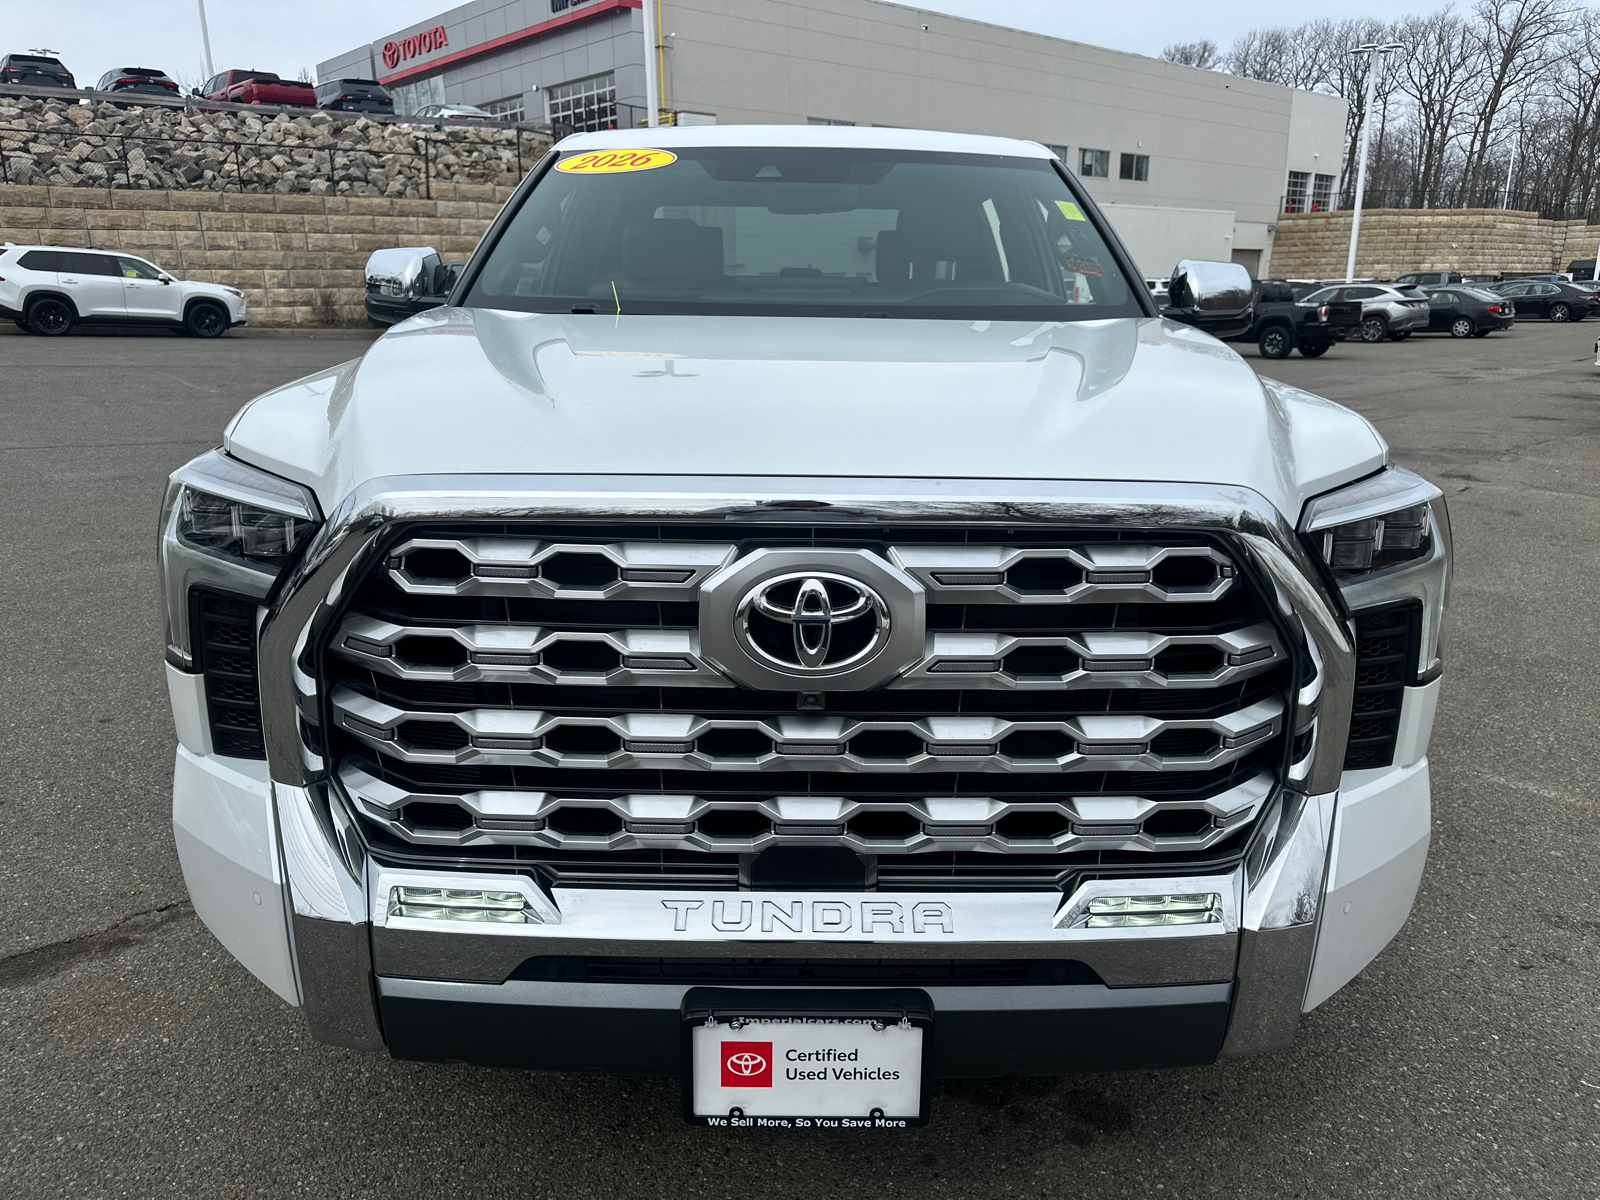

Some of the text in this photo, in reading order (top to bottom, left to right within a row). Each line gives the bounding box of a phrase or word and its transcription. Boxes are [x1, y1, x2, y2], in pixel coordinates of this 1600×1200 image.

[398, 25, 449, 61] TOYOTA
[569, 152, 661, 170] 2026
[661, 899, 954, 933] TUNDRA
[785, 1048, 858, 1062] Certified
[785, 1067, 900, 1080] Used Vehicles
[707, 1117, 906, 1128] We Sell More, So You Save More
